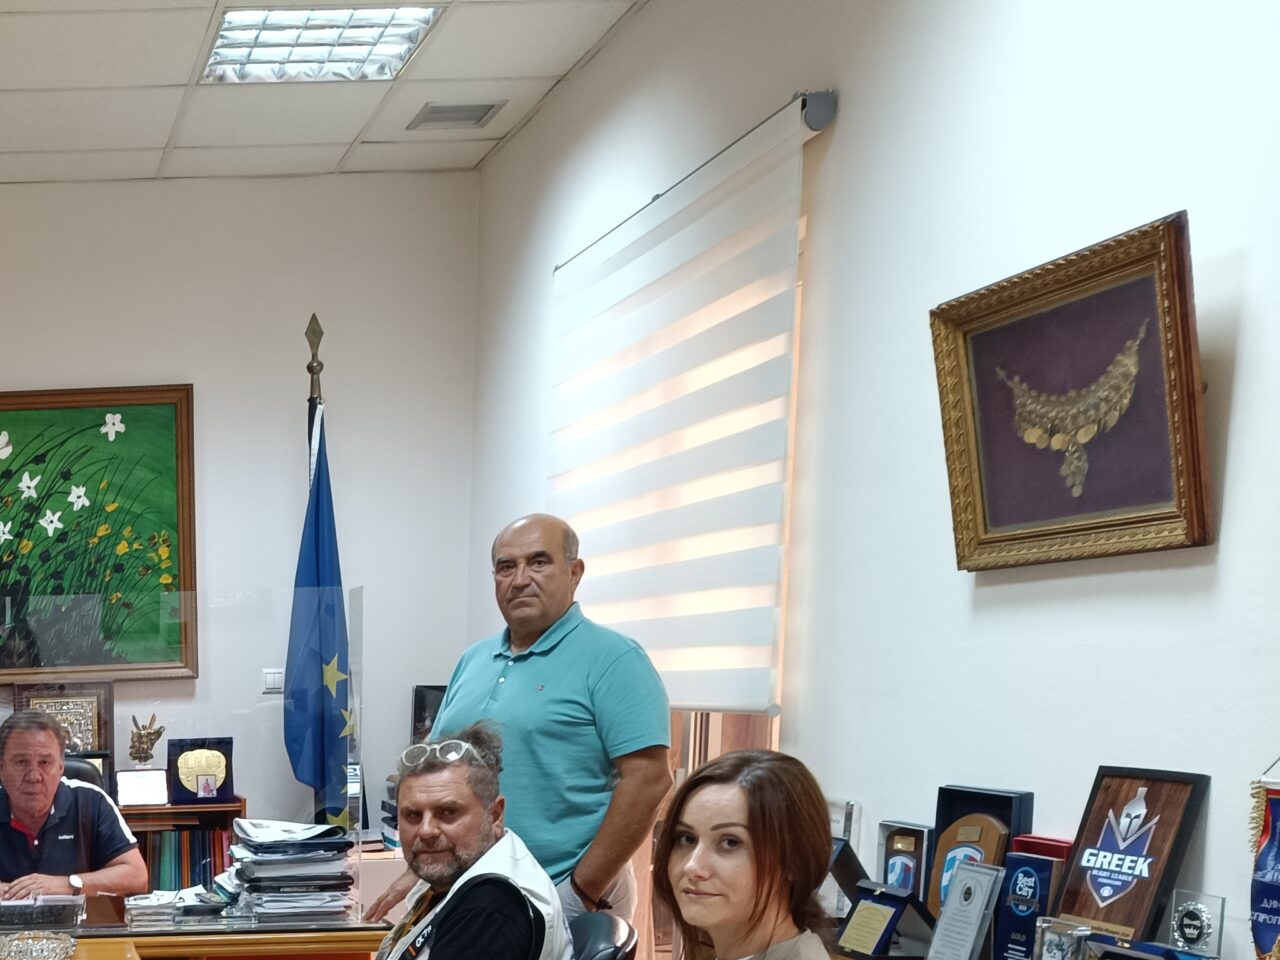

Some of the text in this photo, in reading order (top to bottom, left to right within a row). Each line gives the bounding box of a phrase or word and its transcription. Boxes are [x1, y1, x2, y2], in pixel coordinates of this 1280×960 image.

[1081, 848, 1154, 878] GREEK
[1017, 873, 1035, 887] Best
[1016, 884, 1034, 898] City
